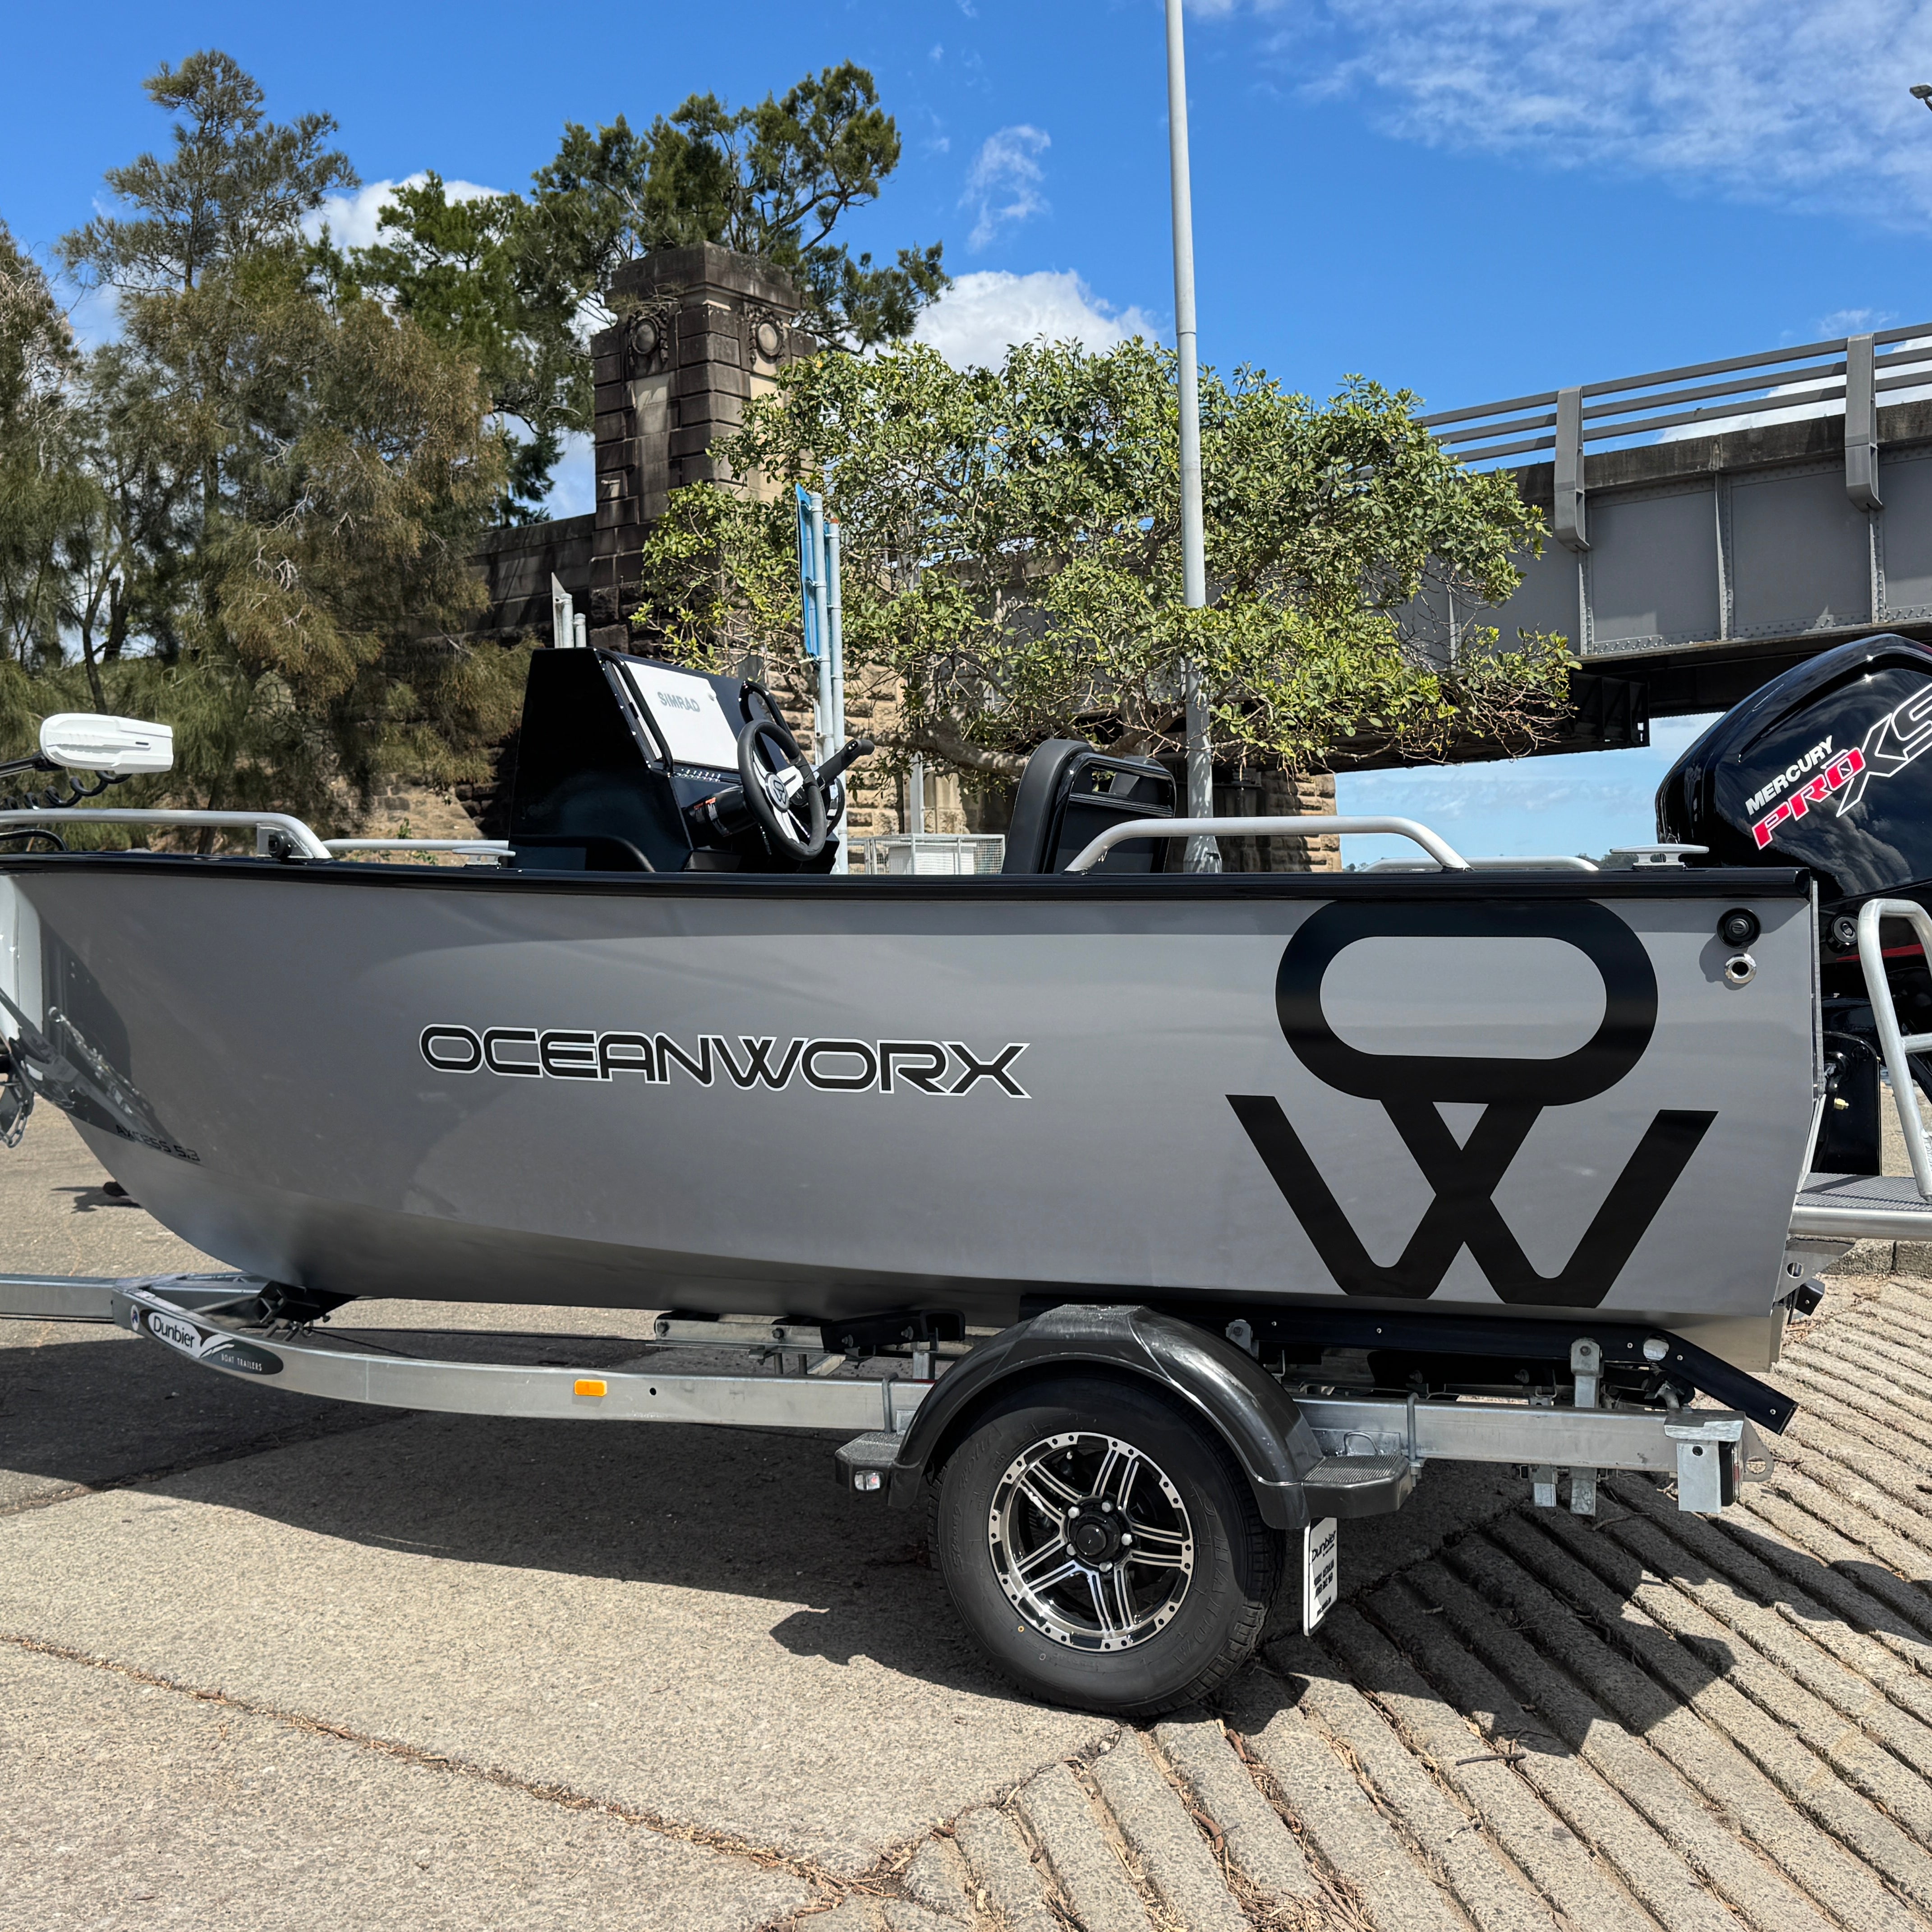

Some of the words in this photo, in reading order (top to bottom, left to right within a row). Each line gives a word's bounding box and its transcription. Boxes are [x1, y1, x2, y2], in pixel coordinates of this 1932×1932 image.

[658, 692, 700, 712] SIMRAD
[1745, 735, 1832, 815] MERCURY
[419, 1024, 1032, 1099] OCEANWORX
[116, 1124, 171, 1153] AXCESS
[173, 1145, 200, 1162] 5.3
[153, 1316, 195, 1348] Dunbier
[221, 1353, 234, 1364] BOAT
[237, 1357, 262, 1371] TRAILERS
